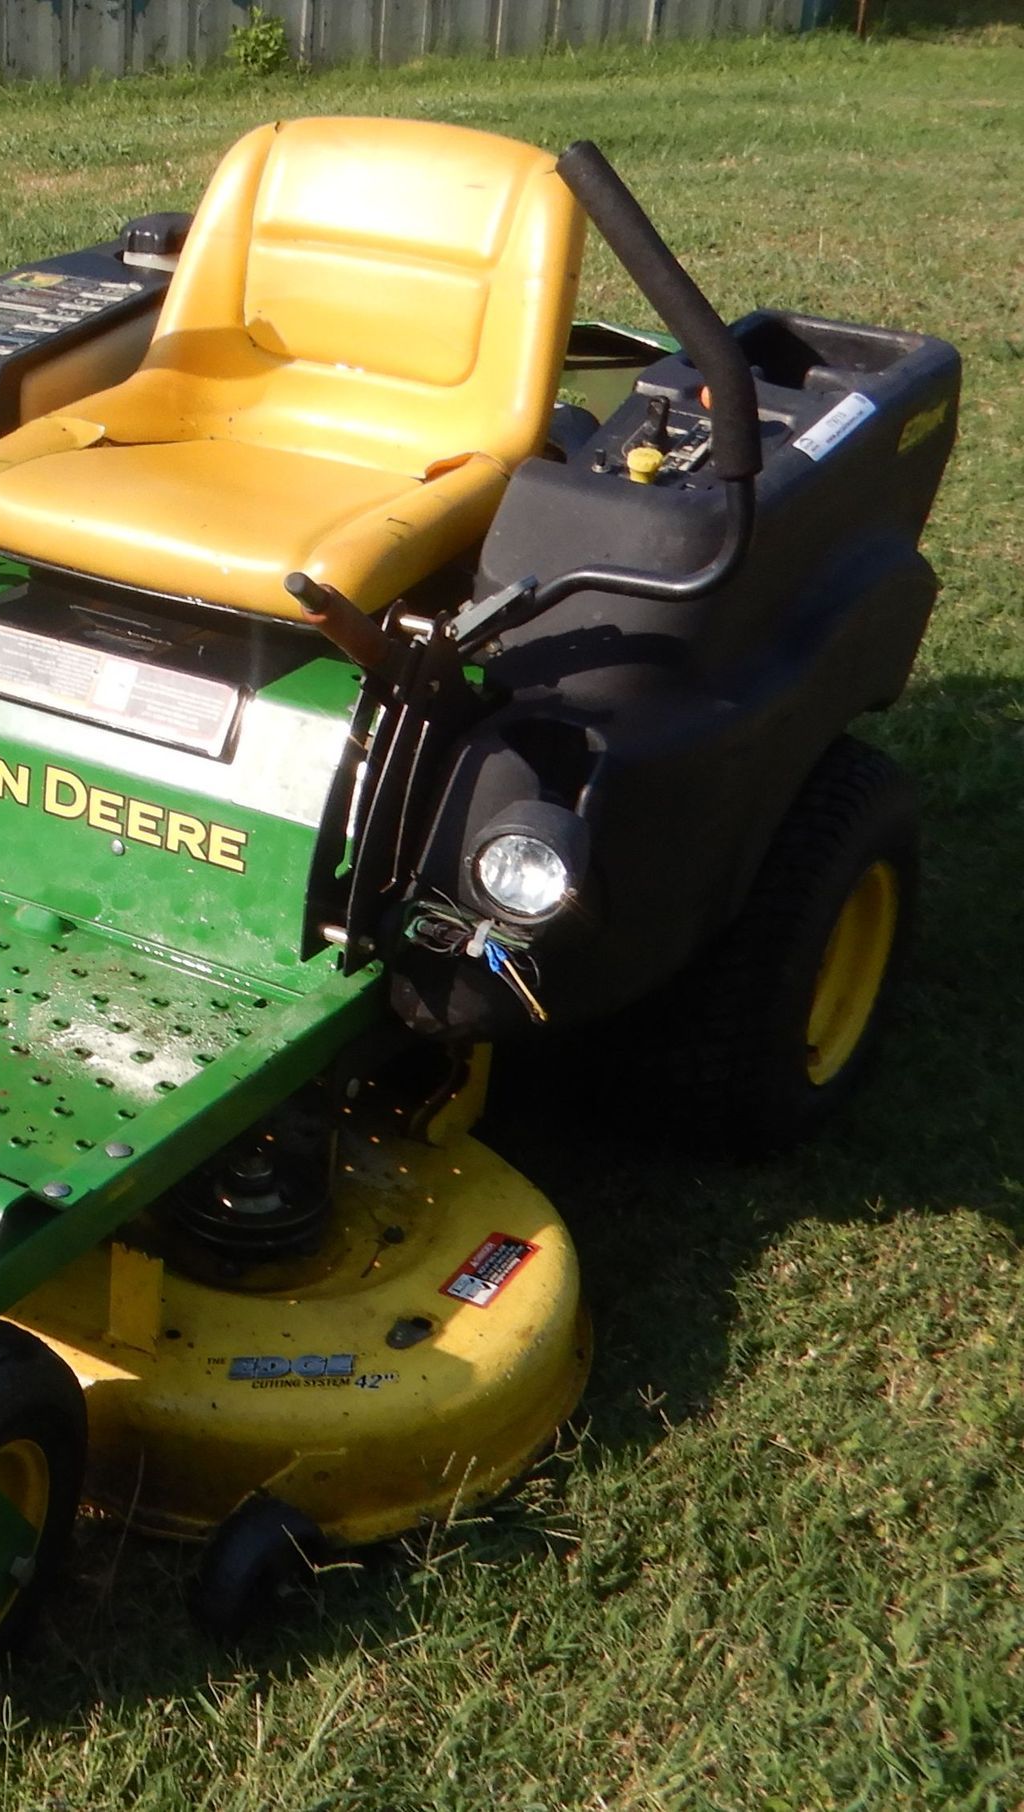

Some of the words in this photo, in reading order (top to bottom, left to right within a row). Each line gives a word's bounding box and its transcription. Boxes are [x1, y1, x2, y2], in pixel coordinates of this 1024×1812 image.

[43, 763, 248, 873] DEERE
[228, 1353, 359, 1381] EDGE
[251, 1377, 301, 1390] CUTTING
[302, 1375, 351, 1388] SYSTEM
